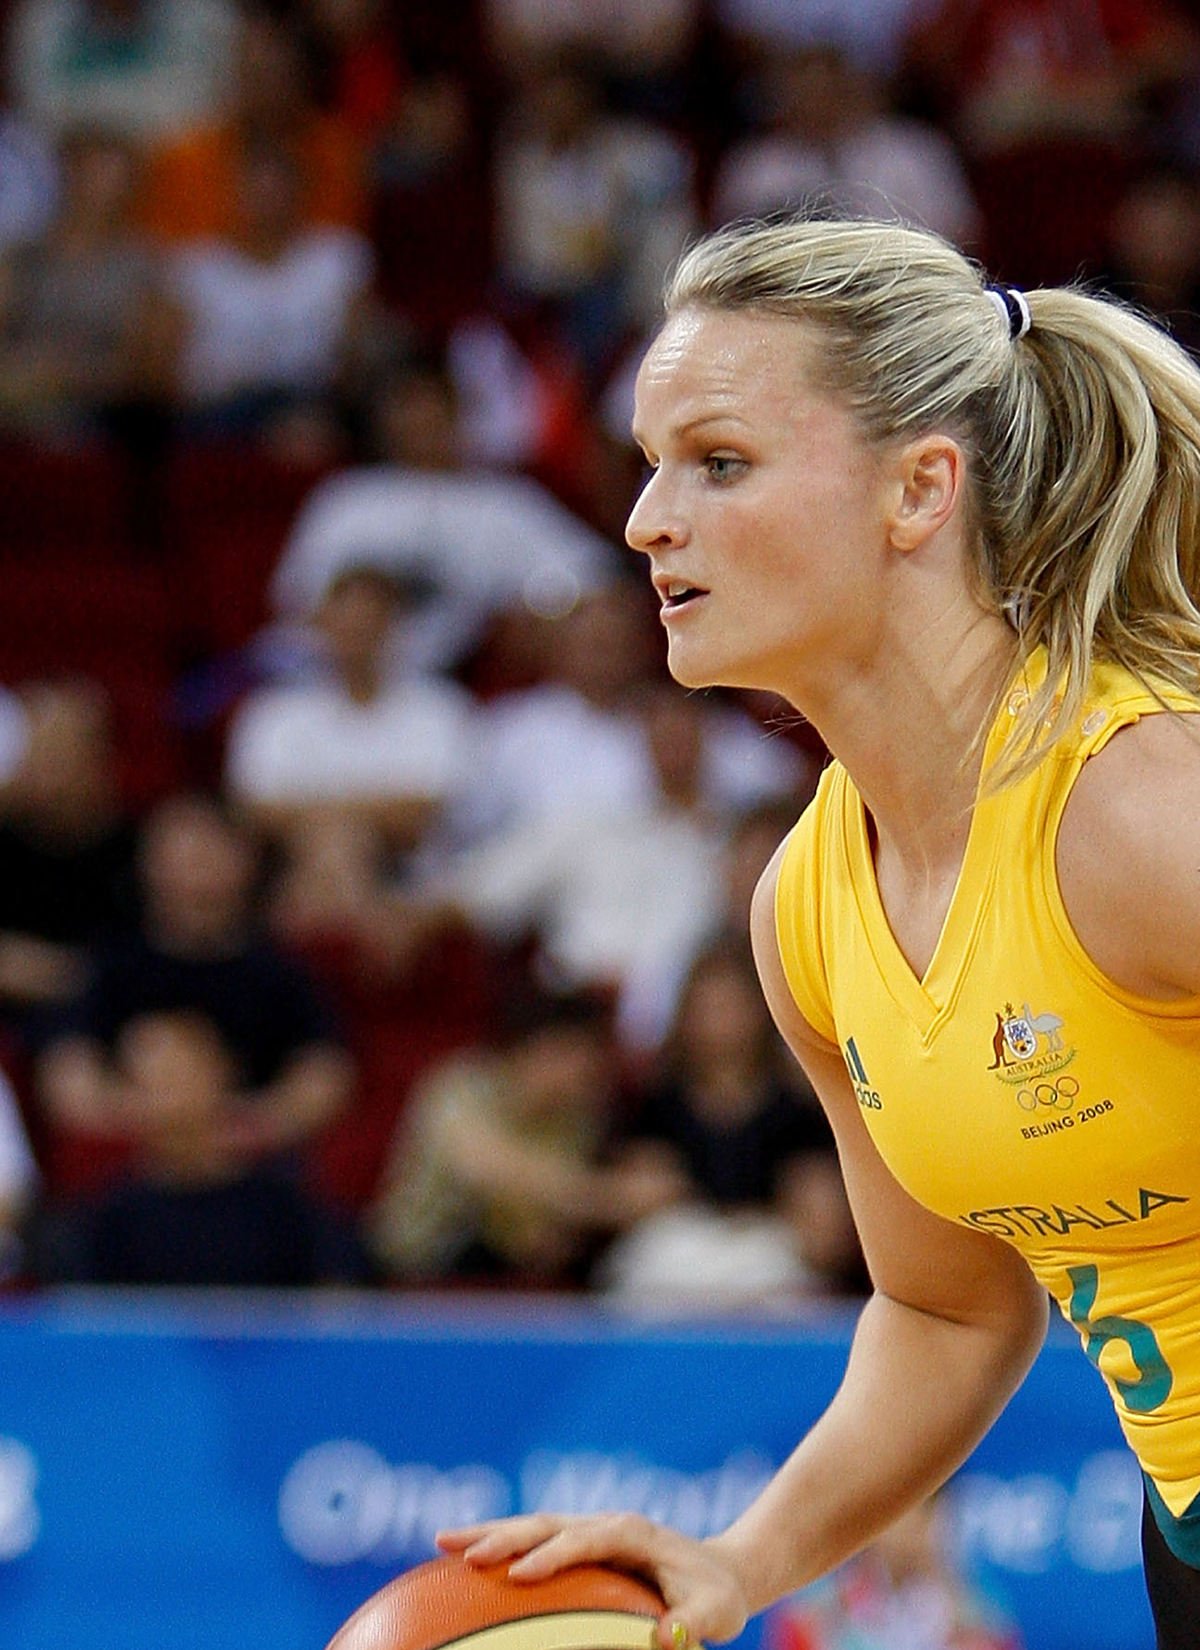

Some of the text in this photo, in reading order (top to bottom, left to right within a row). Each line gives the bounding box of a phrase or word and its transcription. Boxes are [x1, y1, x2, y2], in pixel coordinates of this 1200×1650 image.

[1006, 1052, 1063, 1077] AUSTRALIA
[1021, 1100, 1114, 1139] BEIJING 2008
[1067, 1264, 1173, 1413] 6
